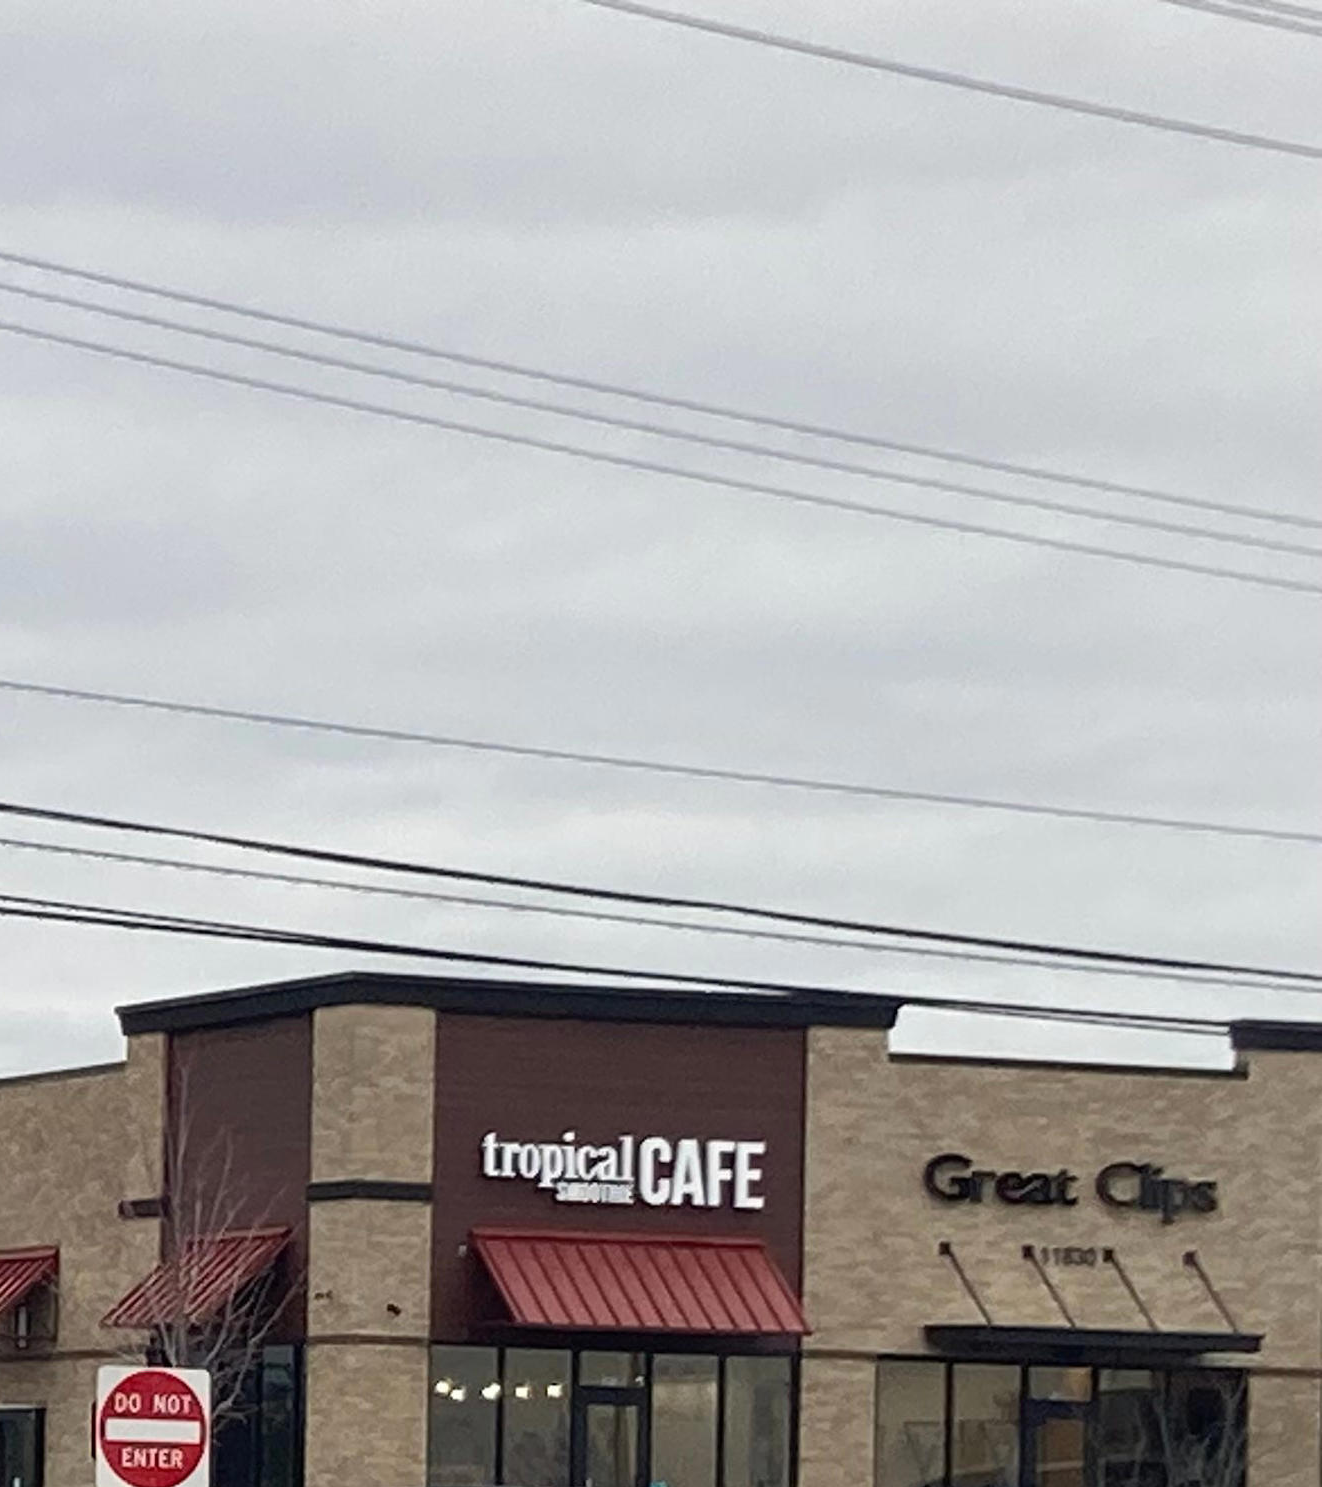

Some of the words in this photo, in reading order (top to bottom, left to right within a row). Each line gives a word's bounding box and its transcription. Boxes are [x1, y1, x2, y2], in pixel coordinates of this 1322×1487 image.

[481, 1131, 635, 1188] tropical
[639, 1137, 765, 1208] CAFE
[924, 1153, 1079, 1205] Great
[1095, 1161, 1218, 1225] Clips
[114, 1392, 141, 1413] DO
[153, 1394, 191, 1414] NOT
[121, 1448, 183, 1469] ENTER
